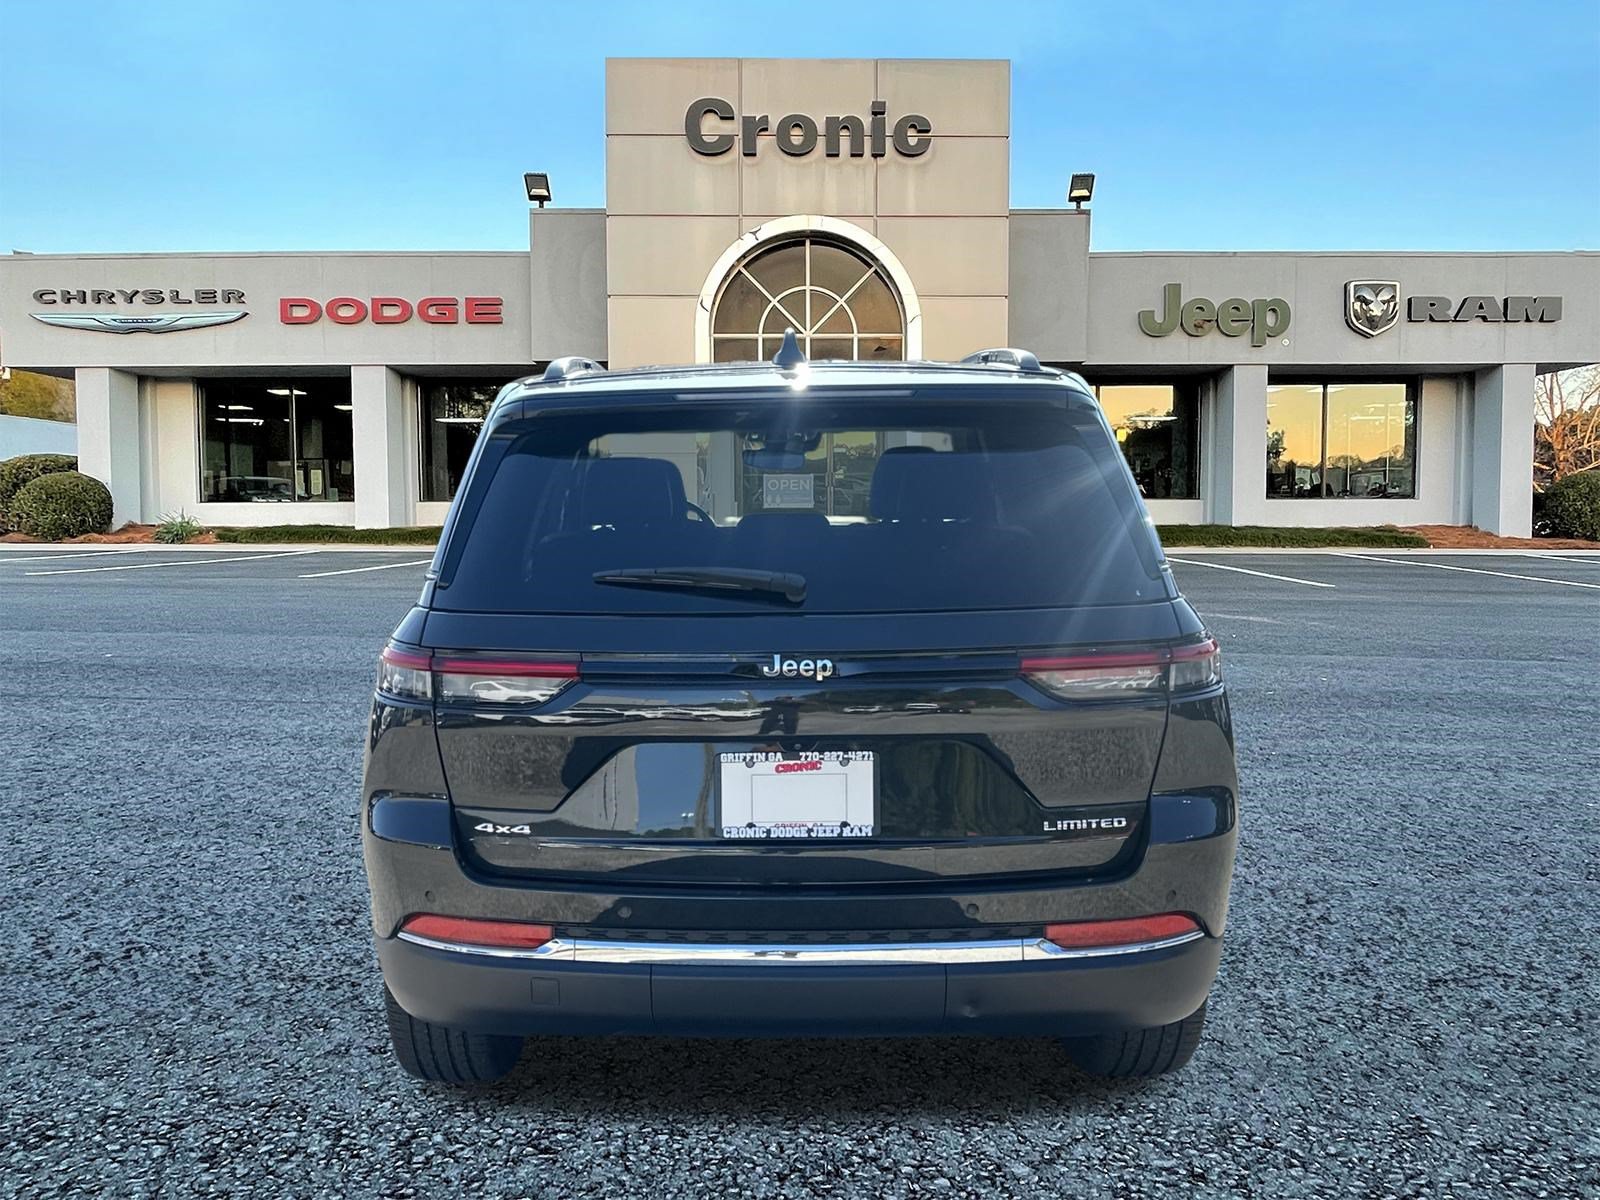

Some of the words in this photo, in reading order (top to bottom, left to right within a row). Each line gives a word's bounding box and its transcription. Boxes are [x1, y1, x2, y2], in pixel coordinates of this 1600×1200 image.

[685, 98, 932, 157] Cronic
[32, 288, 246, 305] CHRYSLER
[279, 297, 504, 325] DODGE
[1138, 283, 1291, 347] Jeep
[1407, 296, 1563, 322] RAM
[767, 480, 810, 490] OPEN
[763, 654, 833, 681] Jeep
[720, 753, 766, 762] GRIFFIN
[768, 753, 783, 762] GA
[799, 751, 874, 761] 770-227-4271
[775, 761, 822, 773] CRONIC
[474, 822, 531, 834] 4x4
[1043, 817, 1127, 831] LIMITED
[723, 827, 767, 838] CRONIC
[770, 826, 808, 838] DODGE
[811, 826, 841, 837] JEEP
